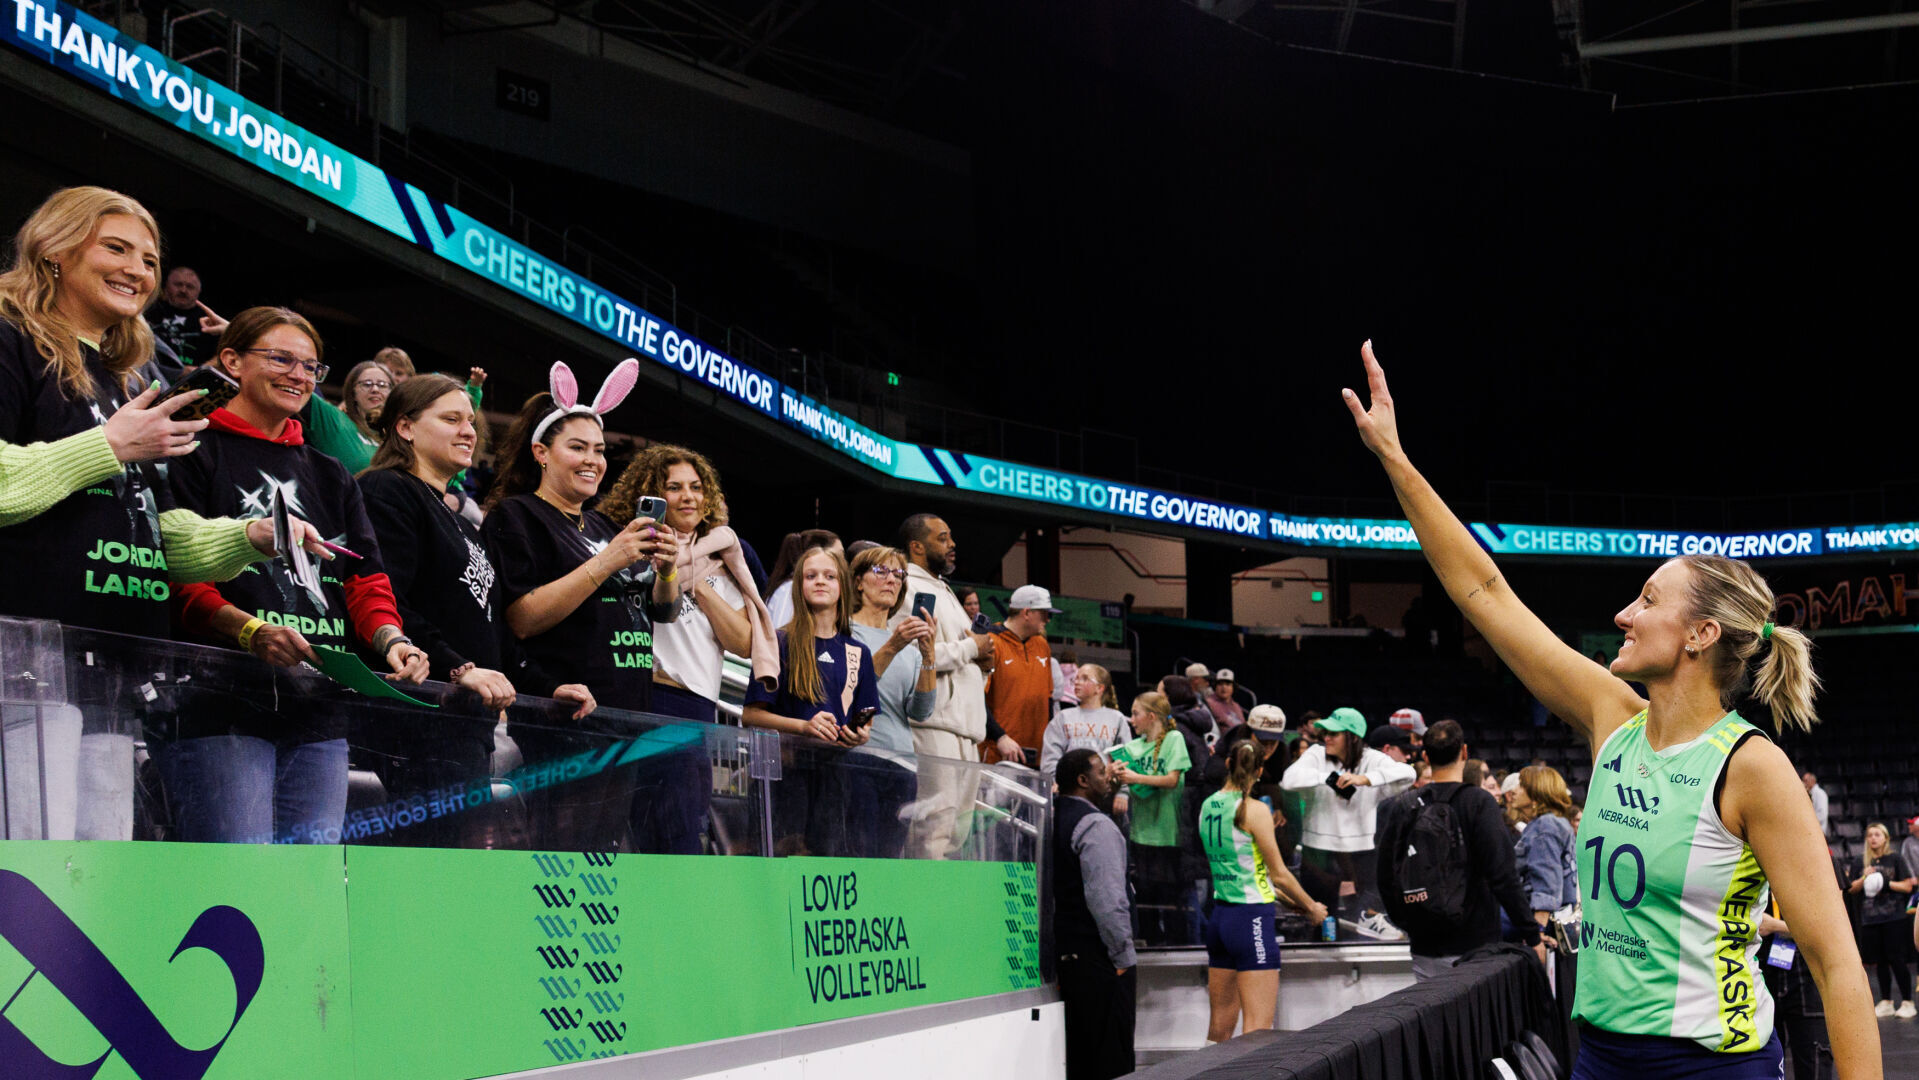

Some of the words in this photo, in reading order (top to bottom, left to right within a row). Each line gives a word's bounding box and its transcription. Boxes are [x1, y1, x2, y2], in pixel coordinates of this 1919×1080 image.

[12, 0, 141, 90] THANK
[145, 61, 220, 136] YOU,
[225, 106, 342, 191] JORDAN
[506, 83, 540, 108] 219
[464, 228, 577, 313] CHEERS
[580, 283, 615, 331] TO
[615, 302, 660, 354] THE
[662, 330, 773, 411] GOVERNOR
[781, 392, 822, 432] THANK
[822, 416, 849, 448] YOU,
[849, 428, 892, 465] JORDAN
[979, 464, 1072, 502] CHEERS
[1076, 482, 1107, 507] TO
[1107, 486, 1149, 515] THE
[1150, 495, 1261, 535] GOVERNOR
[1269, 518, 1319, 540] THANK
[1320, 524, 1362, 543] YOU,
[1362, 526, 1419, 543] JORDA
[1513, 529, 1603, 552] CHEERS
[1606, 533, 1637, 553] TO
[1637, 533, 1679, 555] THE
[1682, 532, 1812, 557] GOVERNOR
[1826, 530, 1888, 549] THANK
[87, 539, 168, 571] JORDA
[85, 570, 170, 601] LARSO
[1775, 573, 1919, 630] OMAH
[609, 630, 653, 647] JORD
[613, 653, 653, 669] LARS
[1205, 813, 1222, 848] 11
[1597, 808, 1650, 832] NEBRASKA
[1585, 836, 1646, 910] 10
[804, 916, 910, 958] NEBRASKA
[1252, 916, 1267, 964] NEBRASKA
[1595, 940, 1647, 960] Medicine
[1718, 873, 1767, 1050] NEBRASKA
[806, 956, 926, 1004] VOLLEYBALL
